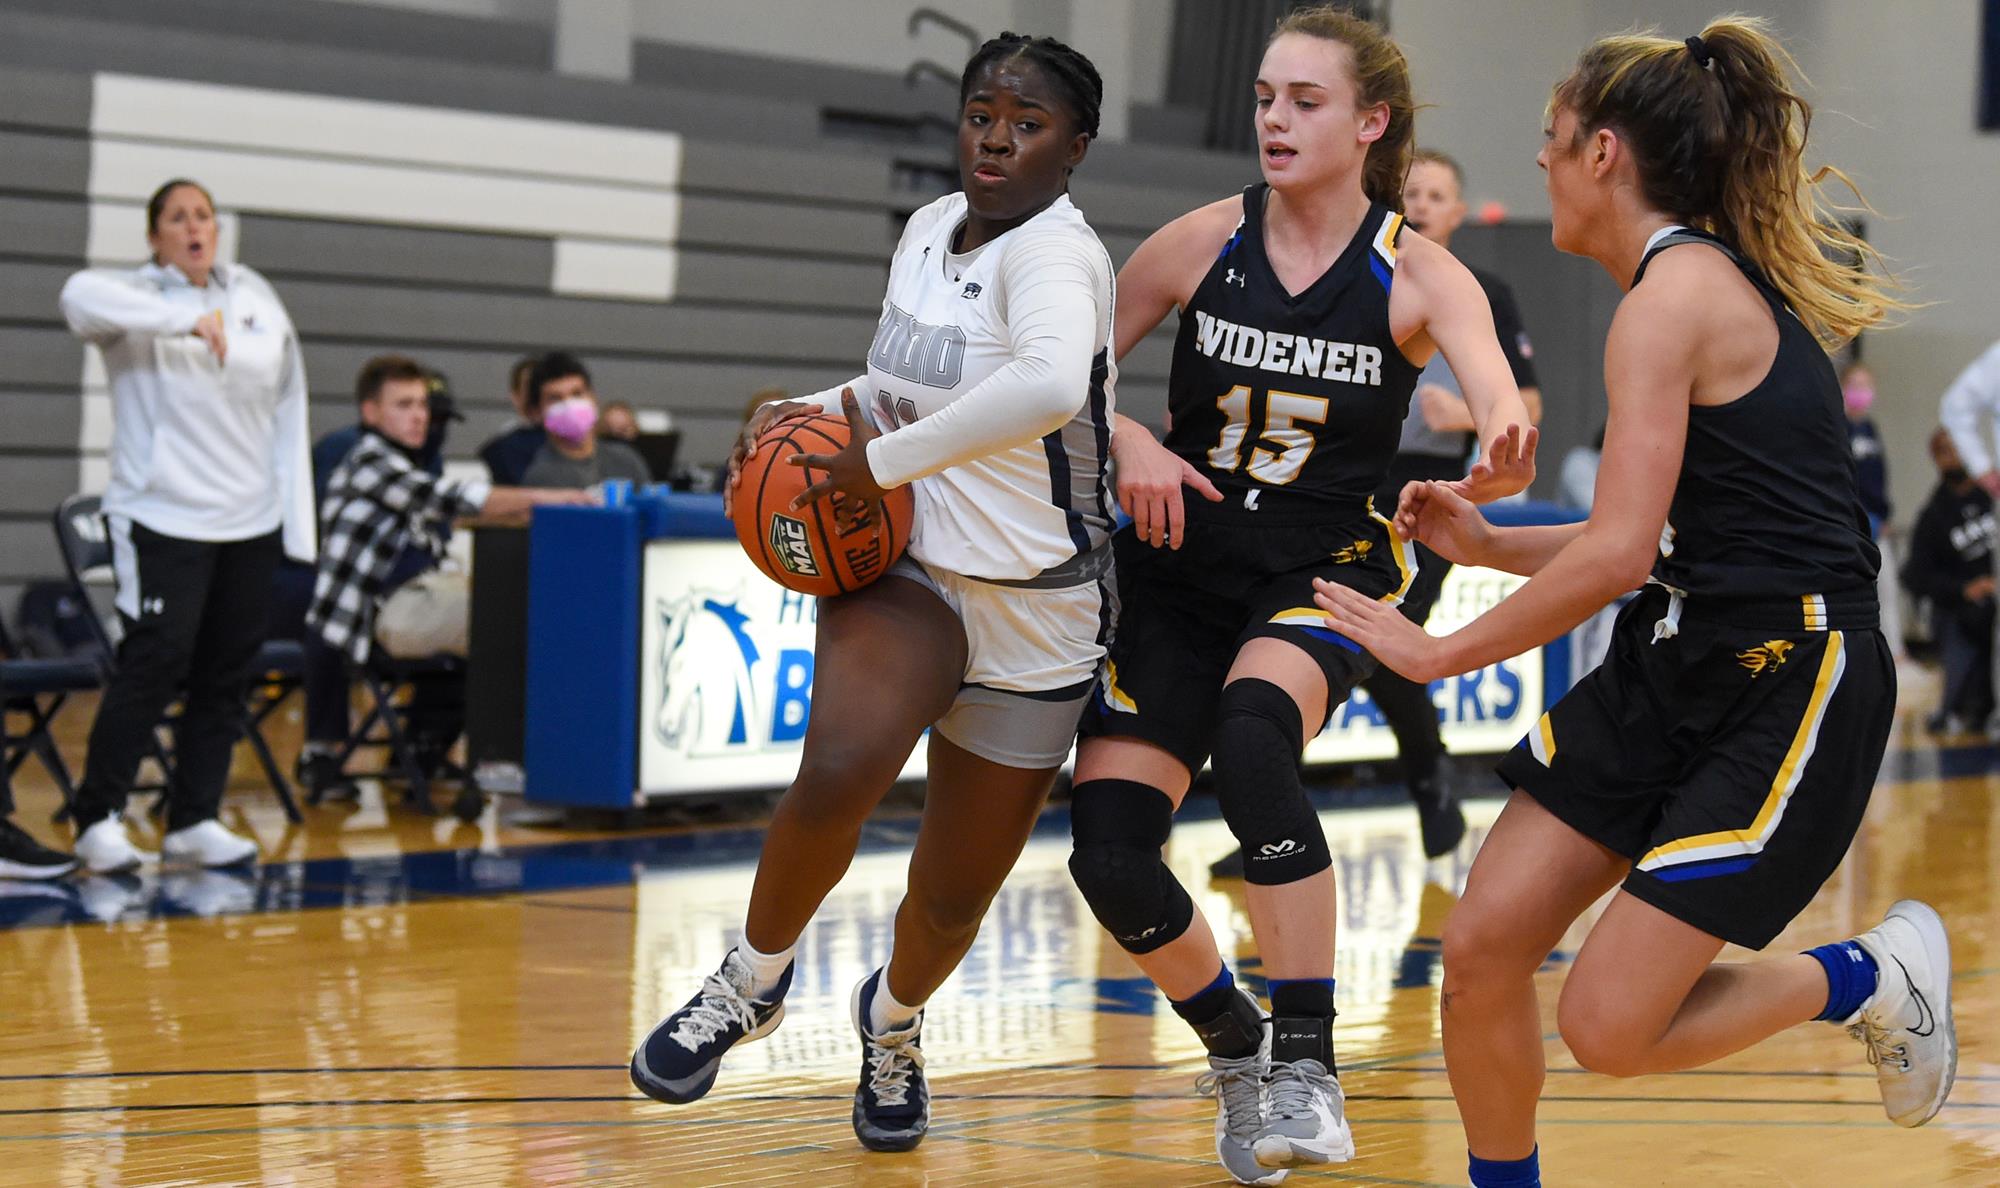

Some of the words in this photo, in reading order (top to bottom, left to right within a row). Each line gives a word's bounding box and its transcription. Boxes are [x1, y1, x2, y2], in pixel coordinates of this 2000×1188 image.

[1195, 310, 1383, 386] WIDENER
[1207, 384, 1330, 485] 15
[786, 522, 817, 575] MAC
[847, 537, 881, 582] THE
